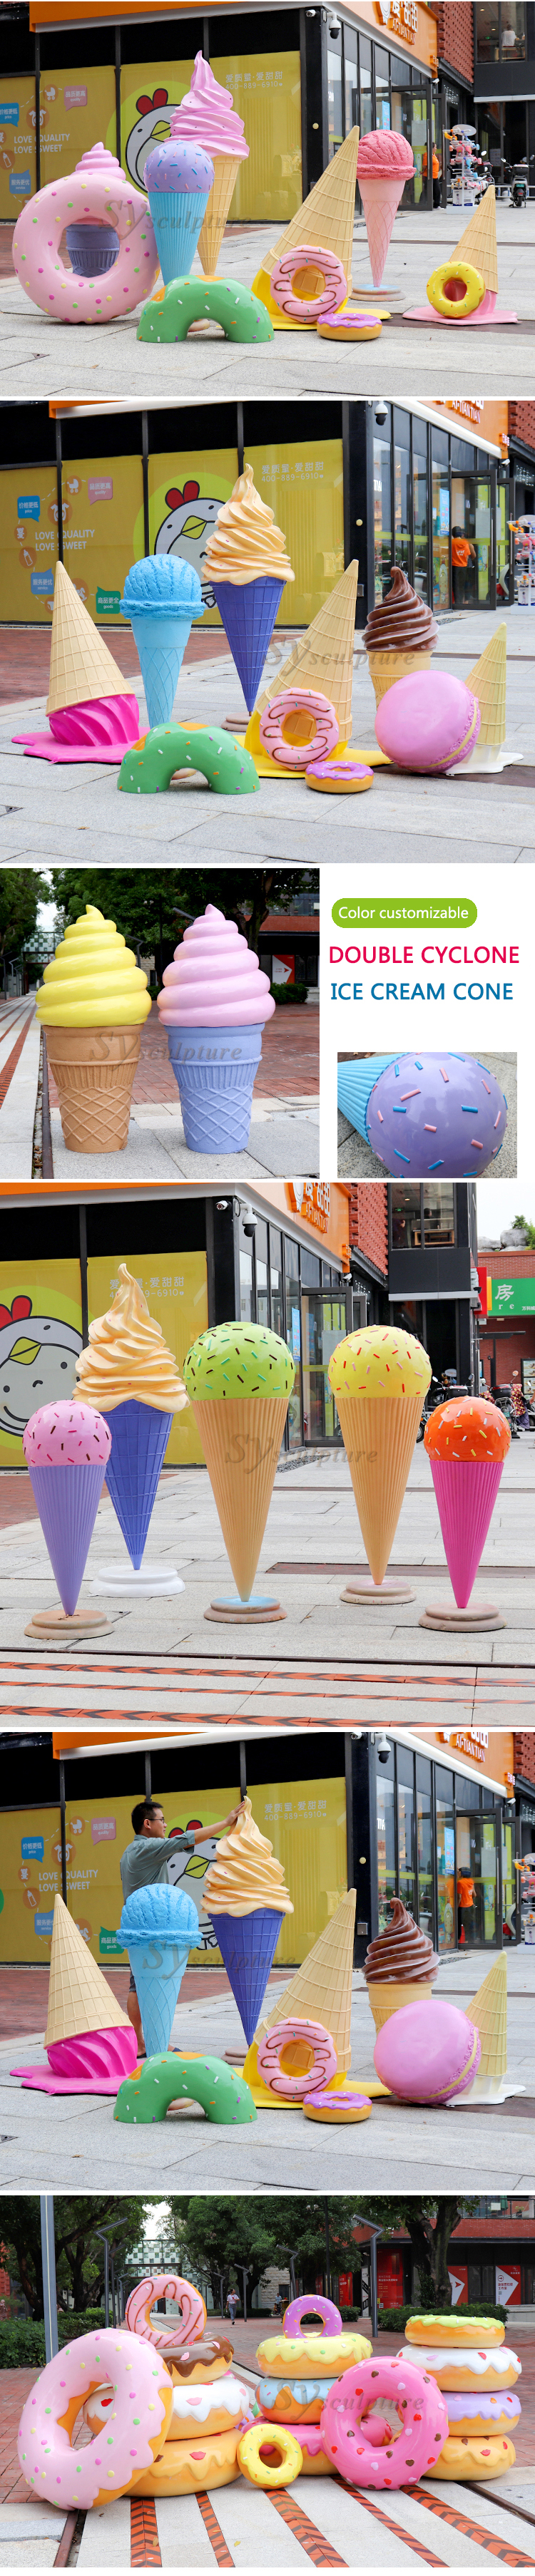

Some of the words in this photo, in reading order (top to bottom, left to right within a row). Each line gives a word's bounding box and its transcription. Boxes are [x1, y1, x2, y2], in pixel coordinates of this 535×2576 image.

[225, 71, 282, 83] 爱质量·爱甜甜
[225, 81, 278, 90] 400-889-6910
[14, 135, 32, 144] LOVE
[14, 145, 33, 154] LOVE
[261, 461, 324, 475] 爱质量·爱甜甜
[261, 472, 318, 482] 400-889-6910
[36, 532, 54, 540] LOVE
[36, 542, 54, 551] LOVE
[495, 1284, 514, 1302] 房
[457, 1733, 485, 1762] AI-TIANTIAN
[264, 1800, 327, 1813] 爱质量·爱甜甜
[264, 1810, 321, 1820] 400-889-6910
[39, 1872, 58, 1880] LOVE
[39, 1883, 58, 1892] LOVE
